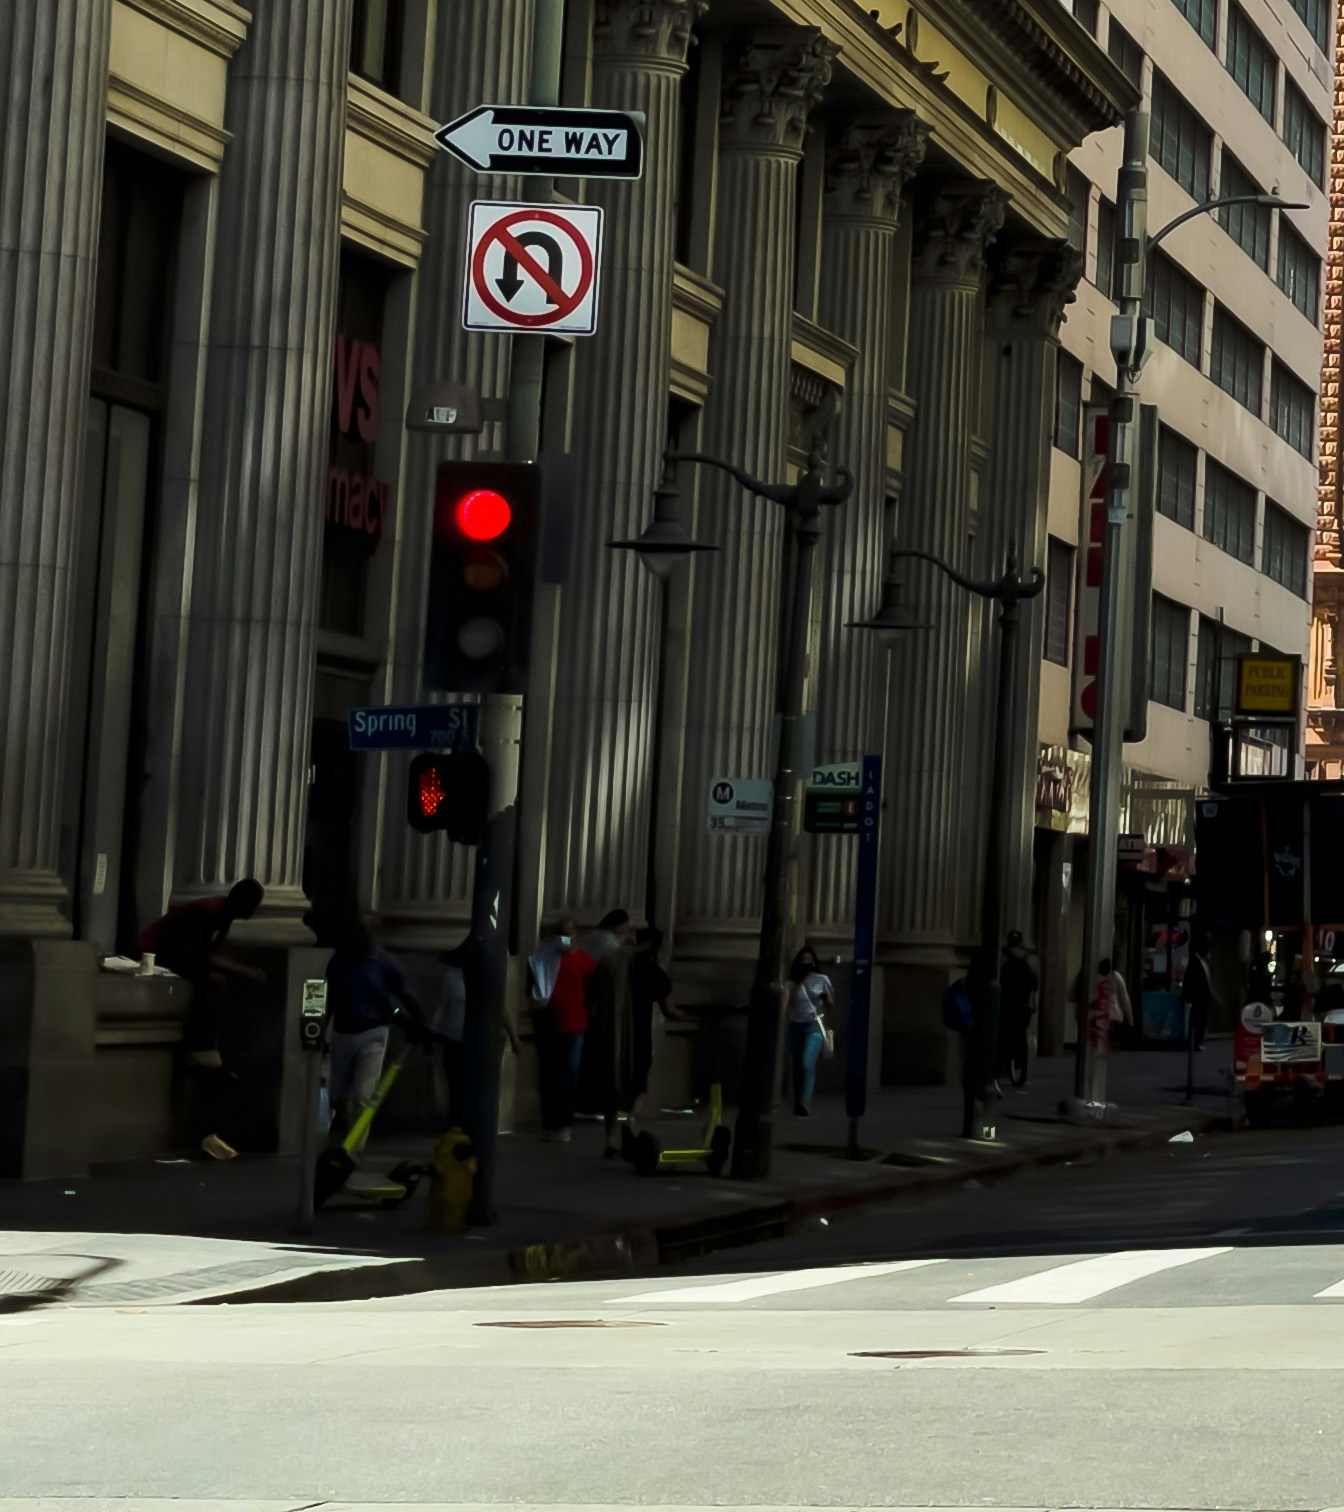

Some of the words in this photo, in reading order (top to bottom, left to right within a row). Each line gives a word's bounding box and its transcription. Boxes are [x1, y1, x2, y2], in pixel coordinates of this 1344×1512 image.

[498, 129, 552, 152] ONE
[564, 131, 620, 156] WAY
[354, 710, 417, 737] Spring
[448, 707, 469, 730] St
[430, 730, 456, 745] 700
[812, 771, 859, 786] DASH
[735, 800, 768, 811] Metro
[864, 769, 876, 843] LADOT
